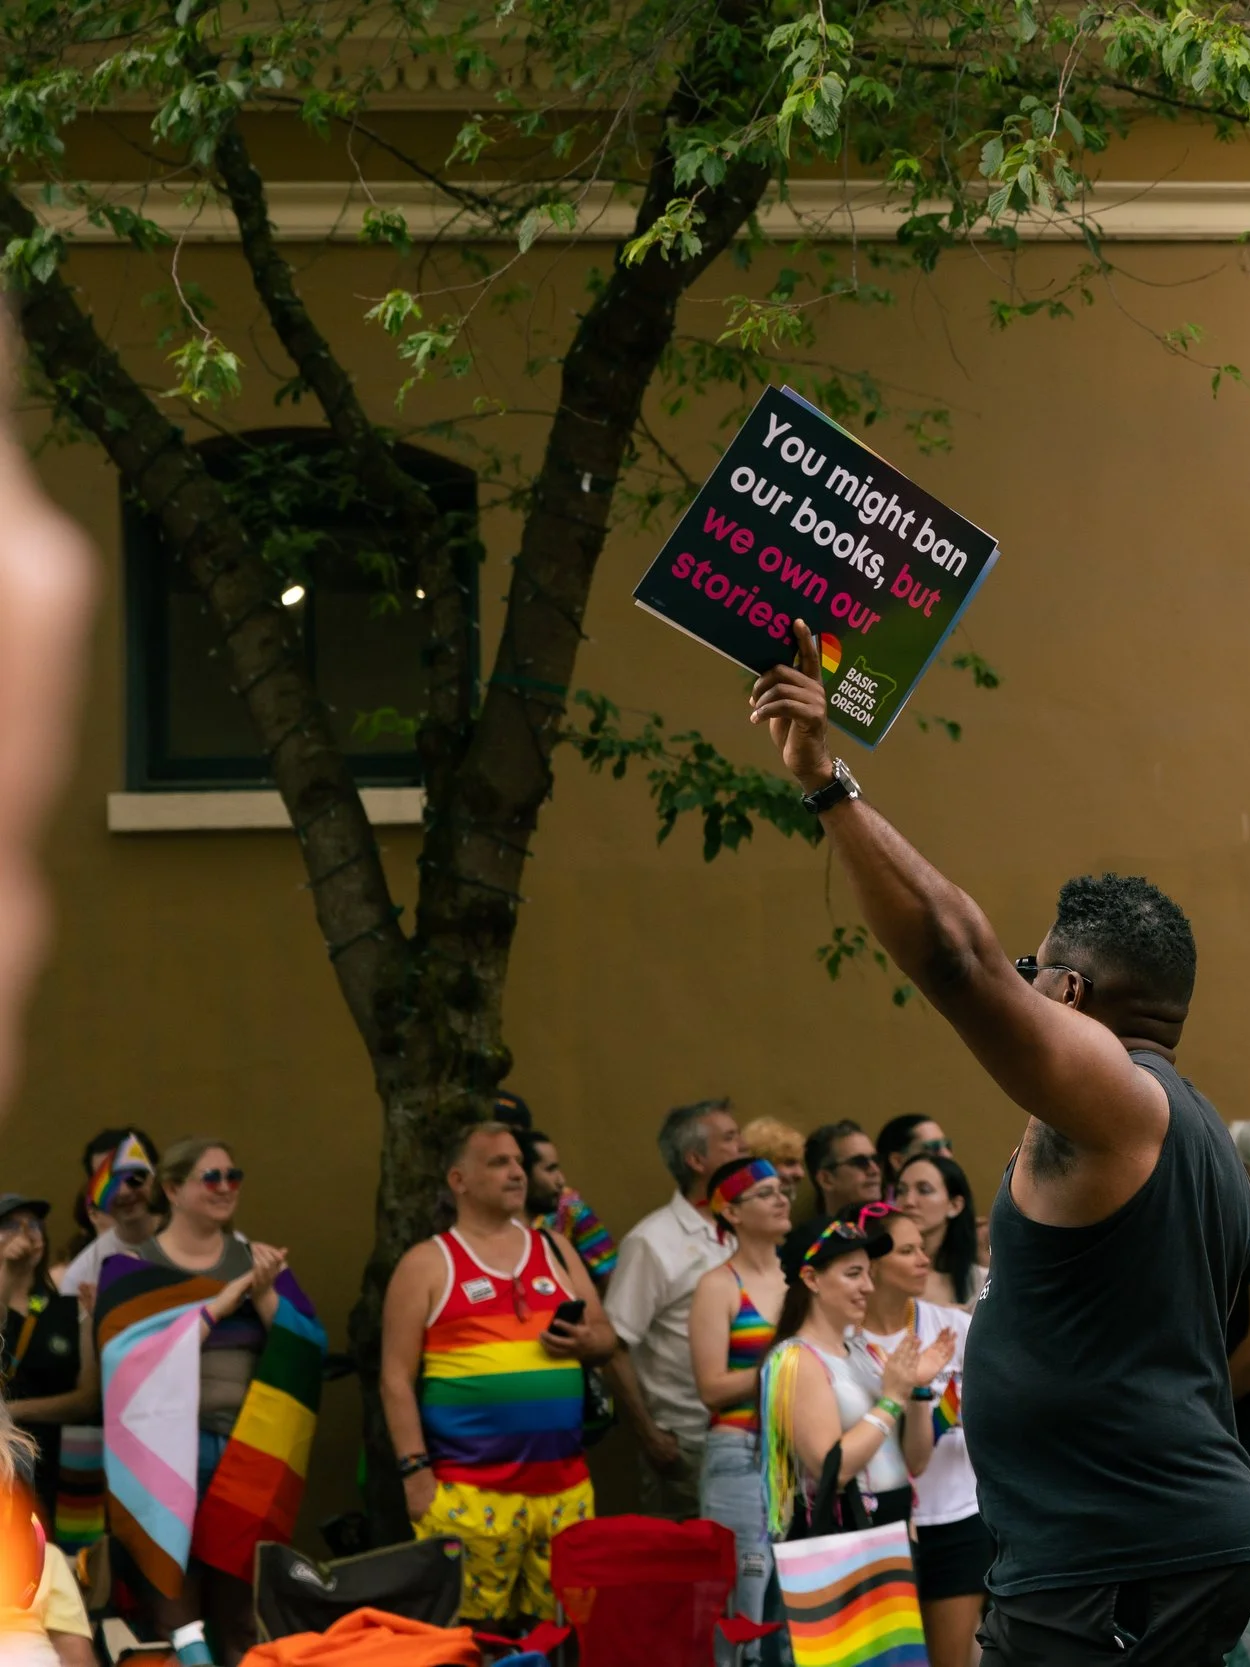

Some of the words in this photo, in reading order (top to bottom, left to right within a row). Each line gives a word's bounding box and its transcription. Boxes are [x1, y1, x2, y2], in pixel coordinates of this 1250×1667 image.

[762, 412, 827, 476] You
[825, 465, 916, 540] might
[912, 518, 967, 577] ban
[703, 507, 754, 554] we
[758, 547, 828, 604] own
[830, 592, 880, 634] our
[730, 466, 793, 515] our
[789, 497, 885, 589] books,
[890, 563, 941, 618] but
[671, 553, 792, 645] stories.
[831, 693, 874, 727] OREGON
[838, 680, 876, 710] RIGHTS
[846, 667, 878, 693] BASIC
